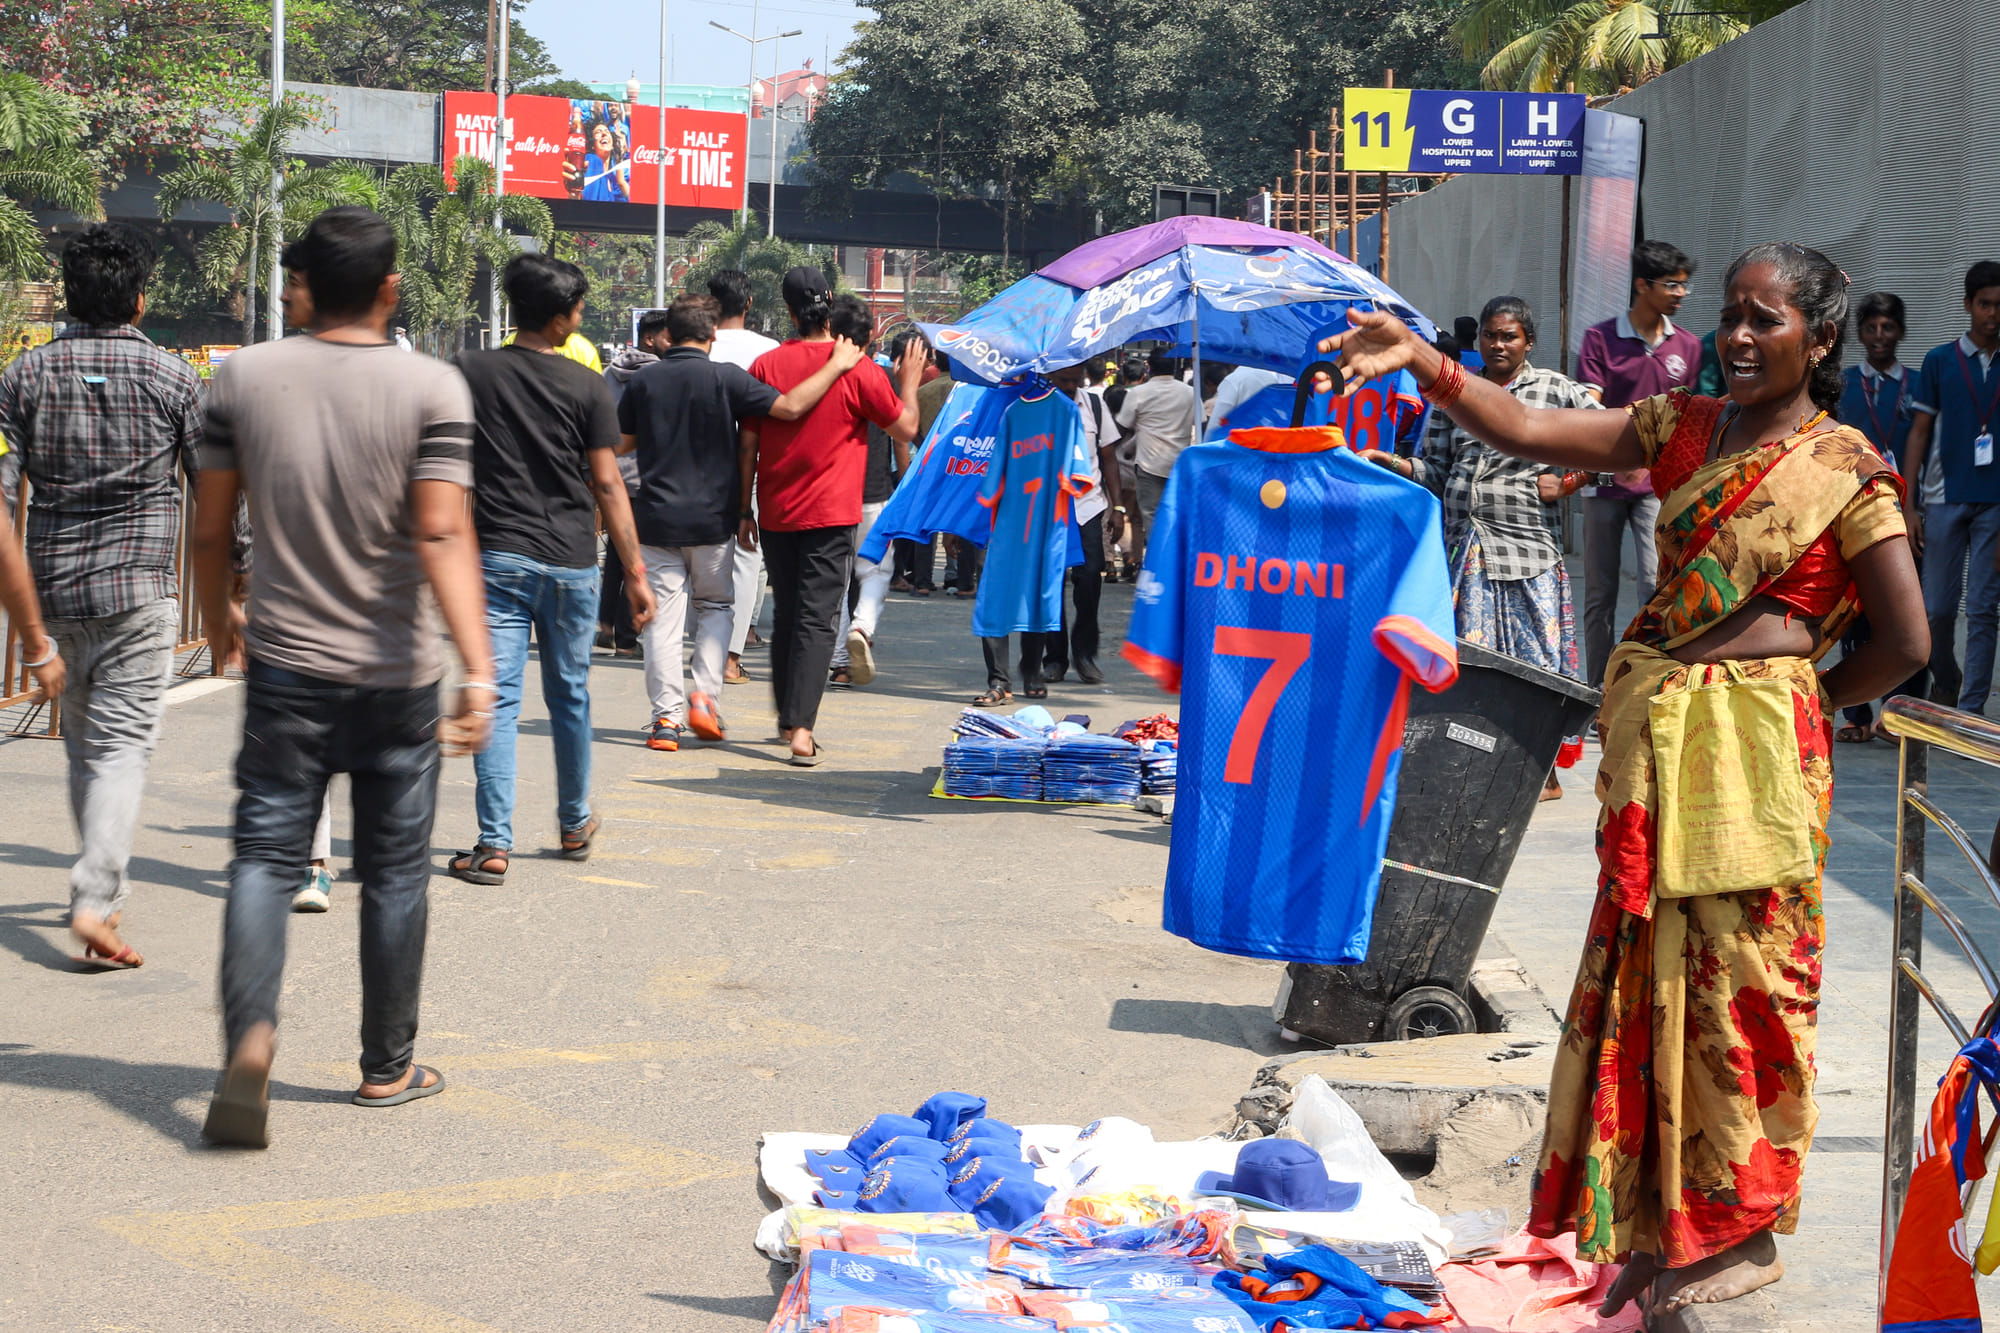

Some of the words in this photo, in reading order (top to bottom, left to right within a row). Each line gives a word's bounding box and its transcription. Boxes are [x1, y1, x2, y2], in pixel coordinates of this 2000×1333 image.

[456, 113, 514, 131] MATC
[1442, 98, 1475, 135] G
[1528, 100, 1558, 136] H
[683, 130, 729, 148] HALF
[1351, 111, 1390, 148] 11
[514, 136, 536, 152] calls
[536, 137, 552, 156] for
[552, 144, 560, 154] a
[1422, 148, 1475, 157] HOSPITALITY
[1475, 149, 1494, 157] BOX
[1442, 138, 1473, 147] LOWER
[1511, 139, 1537, 147] LAWN
[1542, 139, 1574, 148] LOWER
[1444, 158, 1472, 167] UPPER
[1506, 149, 1559, 158] HOSPITALITY
[1560, 150, 1578, 158] BOX
[1528, 159, 1556, 168] UPPER
[678, 148, 733, 188] TIME
[955, 336, 1019, 373] pepsi
[1023, 477, 1043, 544] 7
[1194, 550, 1345, 600] DHONI
[1213, 625, 1311, 785] 7
